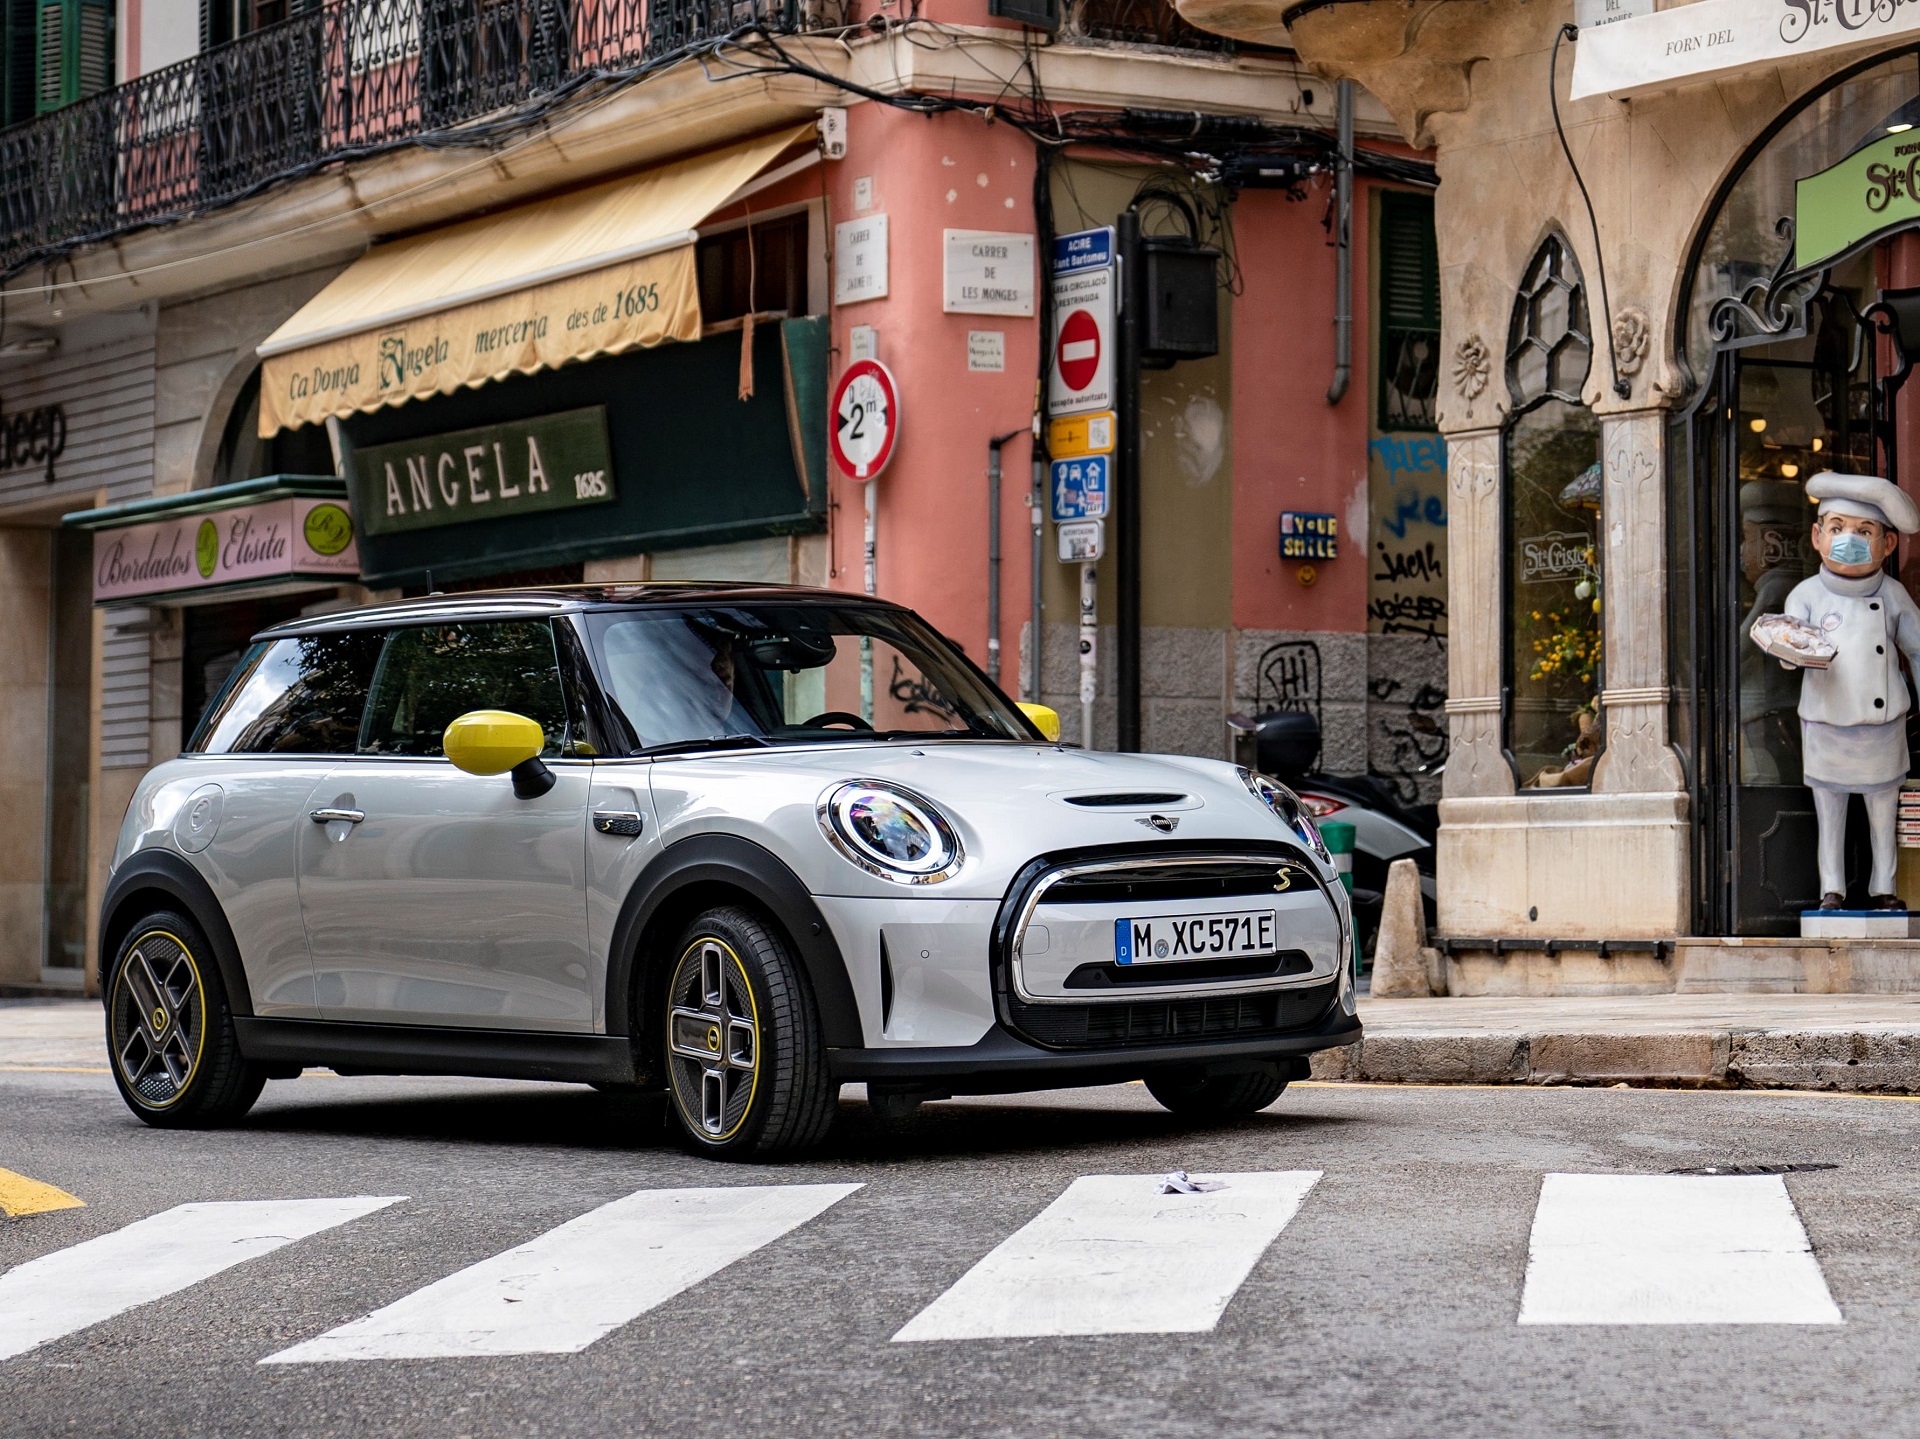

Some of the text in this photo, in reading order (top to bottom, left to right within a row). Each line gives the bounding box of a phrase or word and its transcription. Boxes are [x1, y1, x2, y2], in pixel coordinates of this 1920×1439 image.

[1665, 35, 1701, 56] FORN
[1706, 29, 1735, 47] DEL
[972, 245, 1008, 259] CARRER
[1067, 237, 1092, 252] ACIRE
[1053, 251, 1107, 269] Sant Bartomeu
[984, 266, 996, 279] DE
[962, 286, 1018, 301] LES MONGES
[289, 372, 308, 400] Ca
[312, 363, 360, 396] Donya
[475, 311, 548, 354] merceria
[613, 282, 659, 320] 1685
[384, 436, 608, 517] ANGELA 1685
[98, 528, 192, 589] Bordados
[222, 514, 286, 571] Elisita
[1121, 916, 1274, 957] D M XC571E
